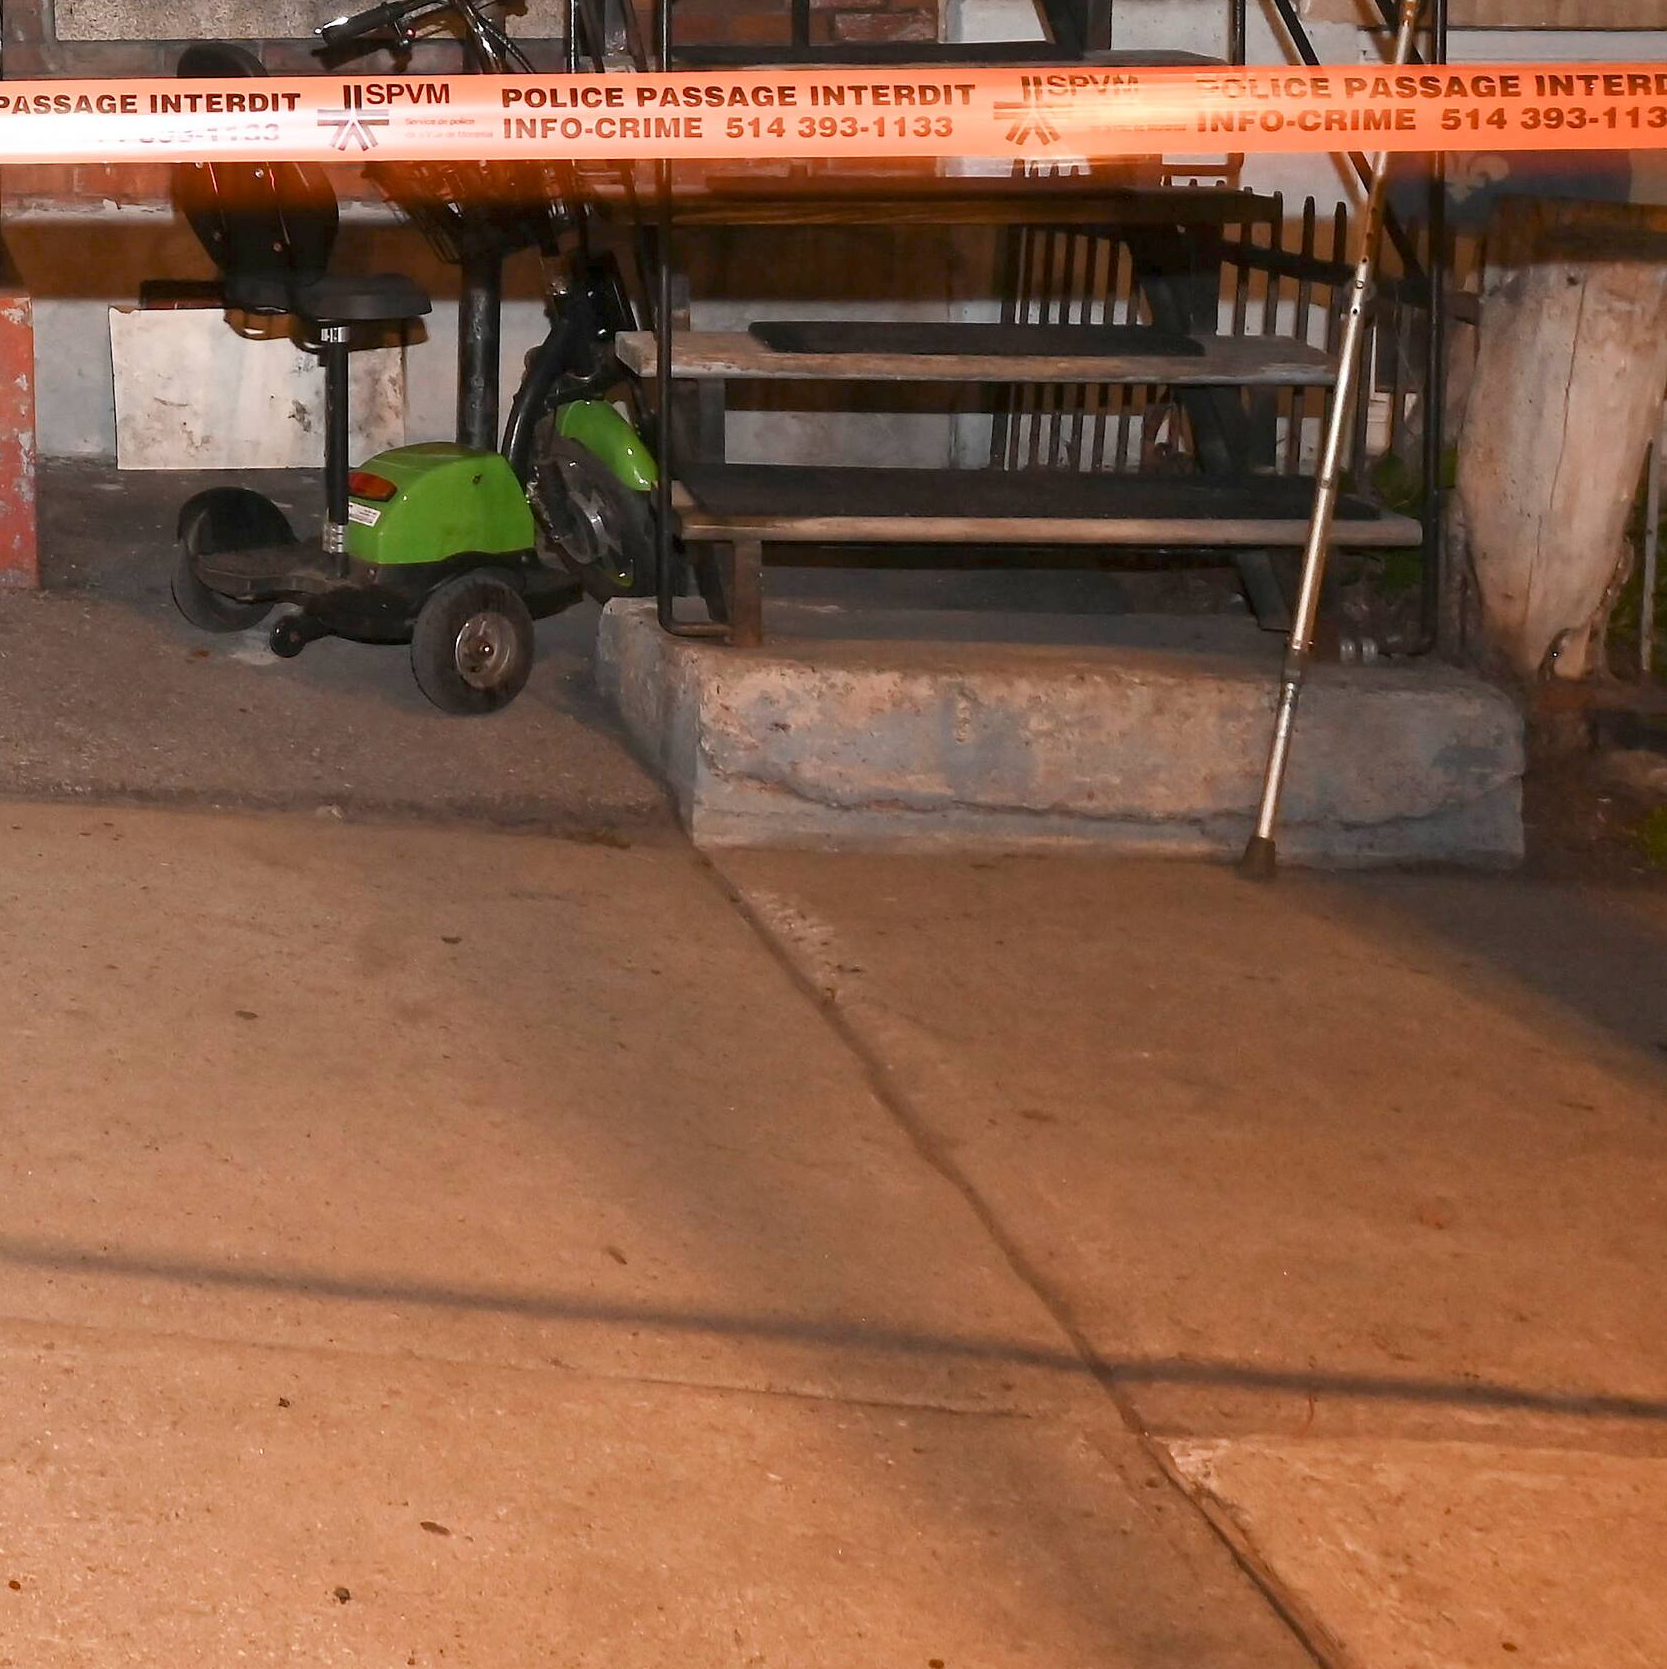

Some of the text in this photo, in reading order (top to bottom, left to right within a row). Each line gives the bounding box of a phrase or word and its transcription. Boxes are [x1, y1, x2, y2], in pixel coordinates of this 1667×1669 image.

[367, 84, 449, 104] SPVM
[1047, 75, 1139, 95] SPVM
[1345, 76, 1521, 98] PASSAGE
[150, 93, 300, 113] INTERDIT
[502, 85, 975, 107] POLICE PASSAGE INTERDIT
[504, 117, 952, 138] INFO-CRIME 514 393-1133
[1198, 109, 1416, 132] INFO-CRIME
[1442, 108, 1507, 130] 514
